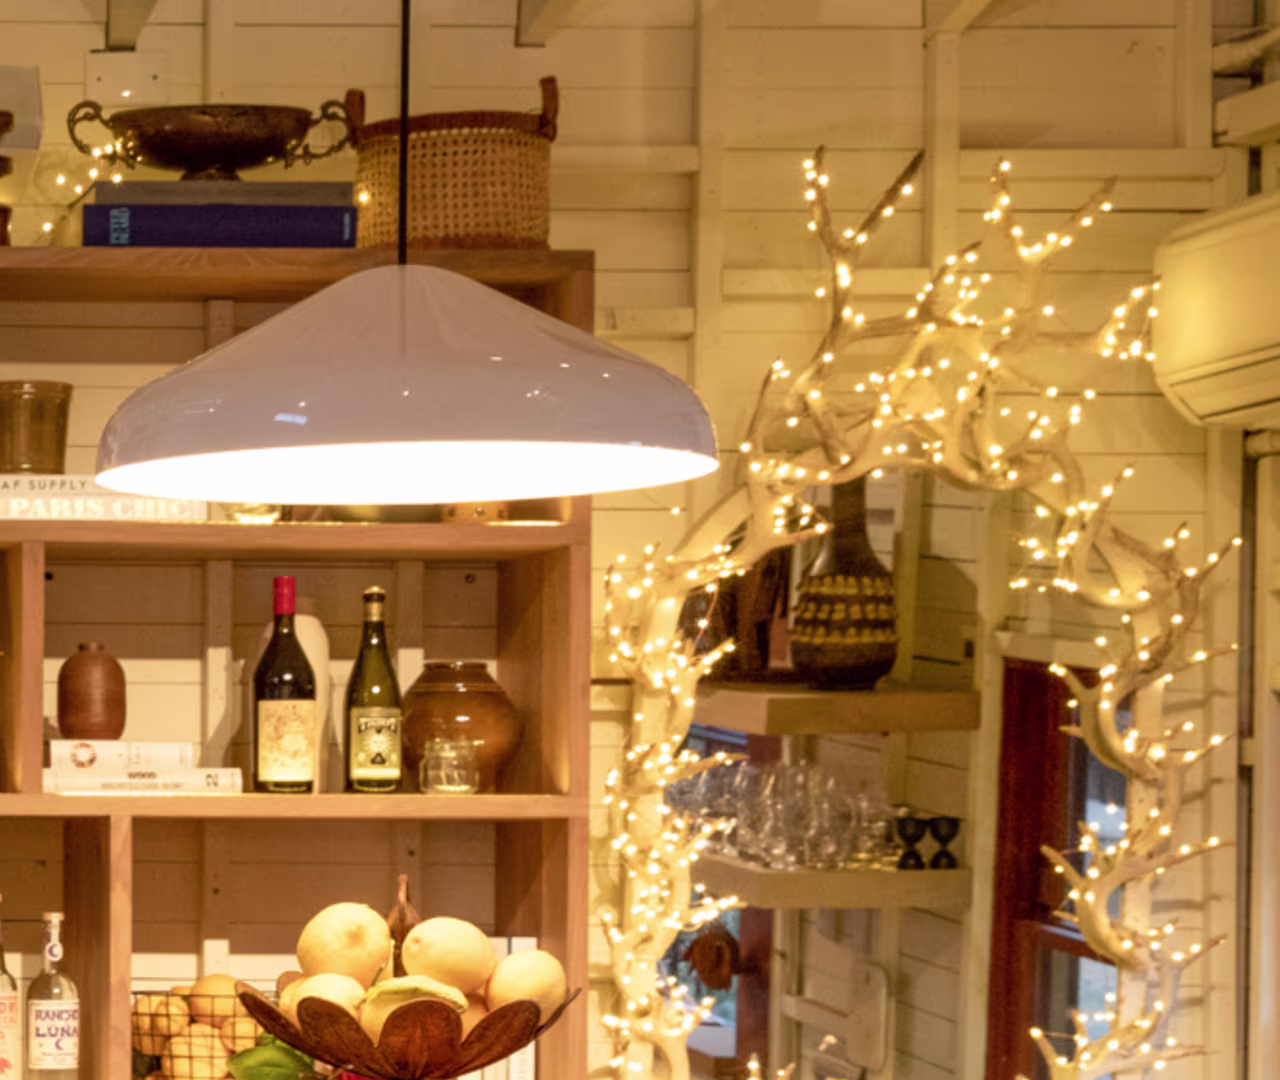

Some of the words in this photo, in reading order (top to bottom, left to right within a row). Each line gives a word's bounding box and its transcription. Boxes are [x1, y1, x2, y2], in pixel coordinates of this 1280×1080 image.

[28, 479, 88, 491] SUPPLY
[8, 497, 104, 518] PARIS
[112, 497, 190, 519] CHIC
